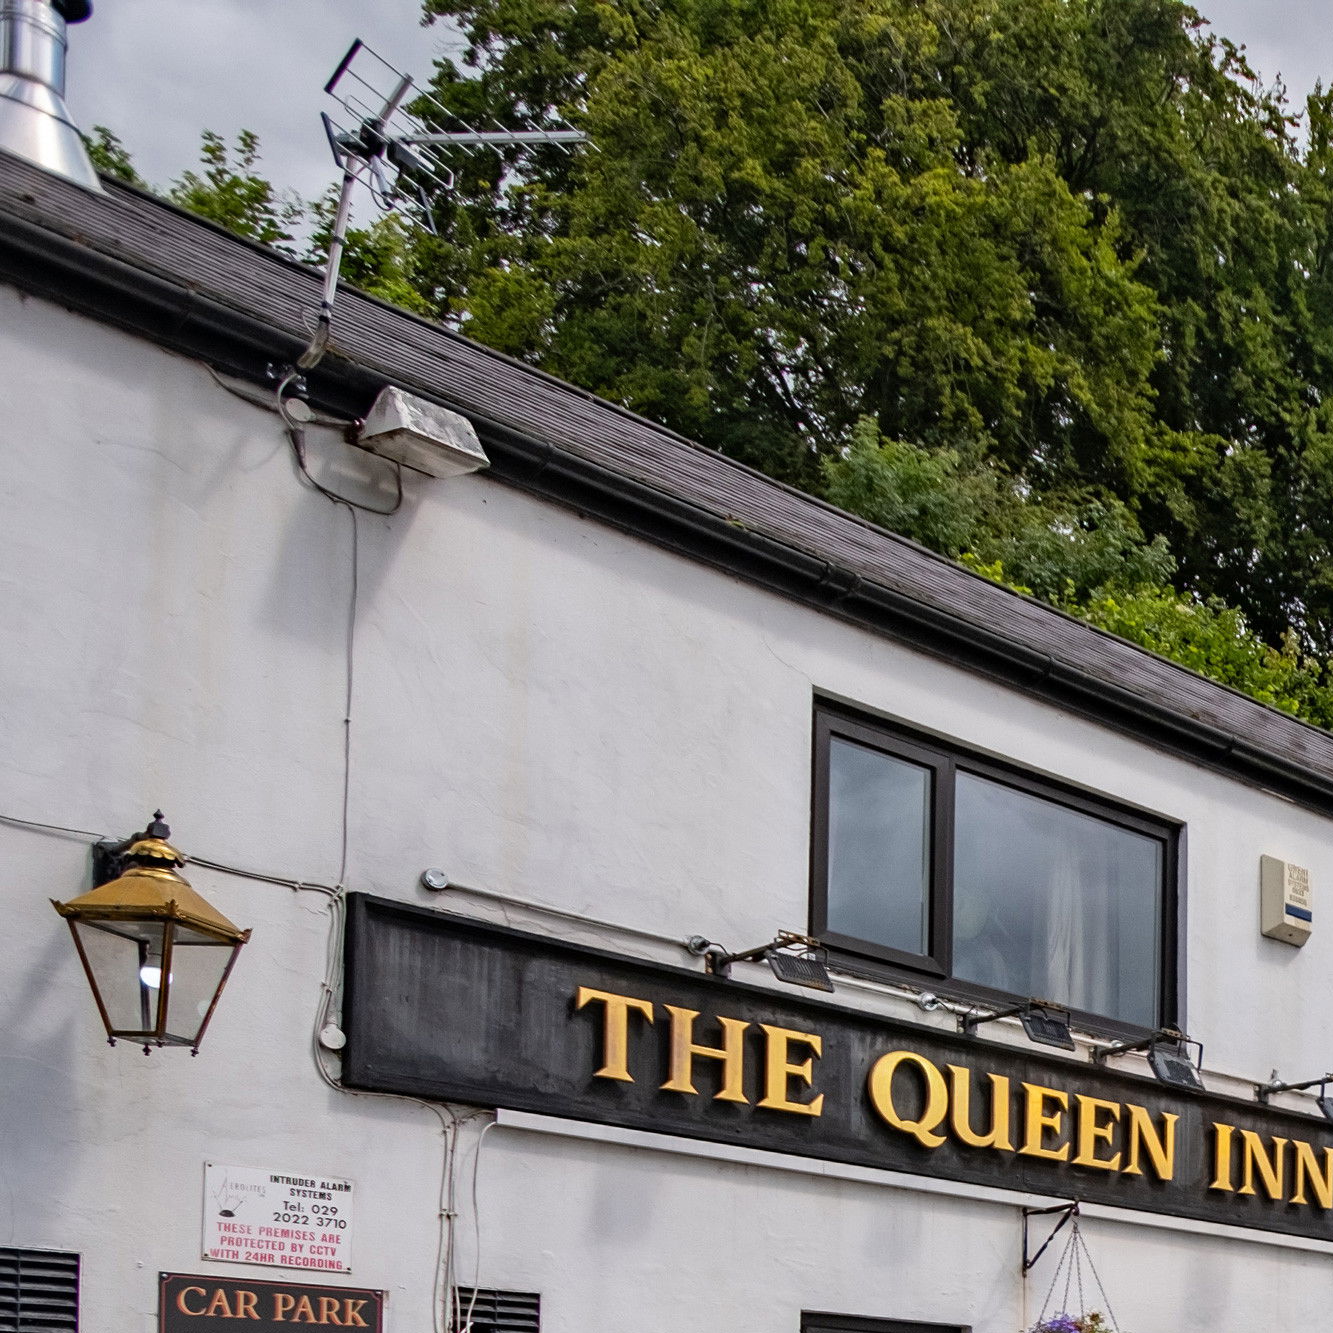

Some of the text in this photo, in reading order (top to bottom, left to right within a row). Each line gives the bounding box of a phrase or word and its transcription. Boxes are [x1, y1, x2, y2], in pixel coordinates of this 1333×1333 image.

[577, 986, 825, 1117] THE
[868, 1050, 1180, 1182] QUEEN
[270, 1174, 351, 1192] INTRUDER ALARM
[289, 1188, 332, 1201] SYSTEMS
[283, 1200, 338, 1216] Tel: 029
[273, 1212, 347, 1229] 2022 3710
[217, 1222, 341, 1245] THESE PREMISES ARE
[220, 1235, 337, 1257] PROTECTED BY CCTV
[210, 1248, 343, 1270] WITH 24HR RECORDING
[176, 1286, 370, 1327] CAR PARK
